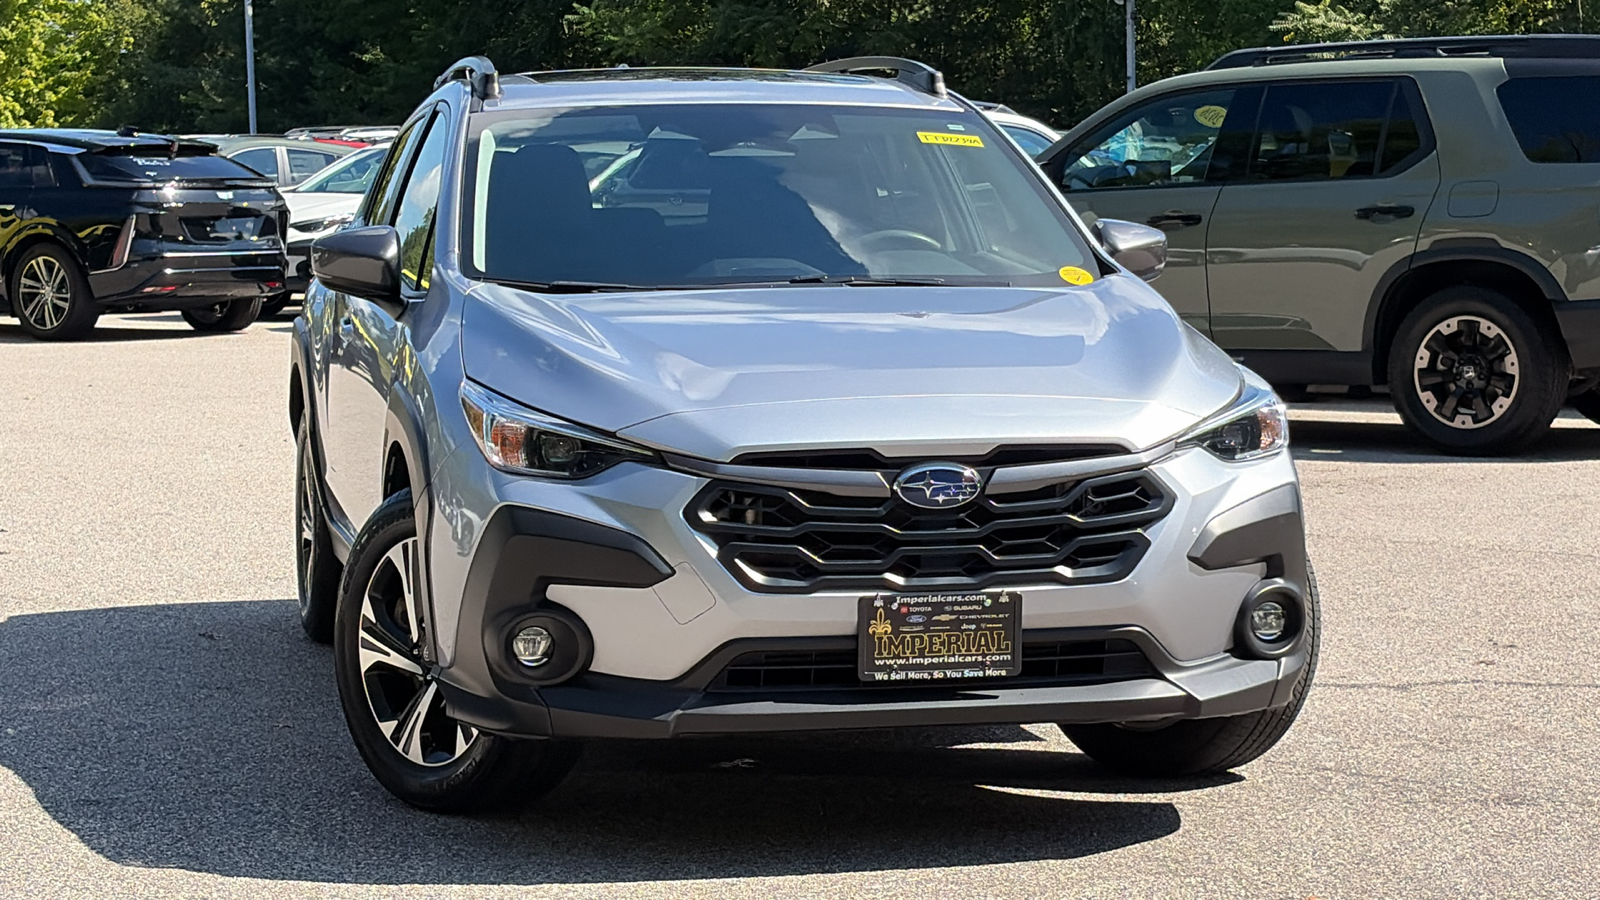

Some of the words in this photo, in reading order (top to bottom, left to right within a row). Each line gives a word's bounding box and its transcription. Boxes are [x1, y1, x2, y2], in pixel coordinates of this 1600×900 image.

[896, 594, 987, 605] Imperialcars.com
[874, 631, 1011, 658] IMPERIAL
[874, 653, 1012, 666] www.imperialcars.com
[890, 671, 906, 680] Sell
[908, 671, 931, 680] More,
[933, 670, 944, 679] So
[946, 670, 962, 678] You
[963, 669, 984, 677] Save
[985, 667, 1007, 677] More
